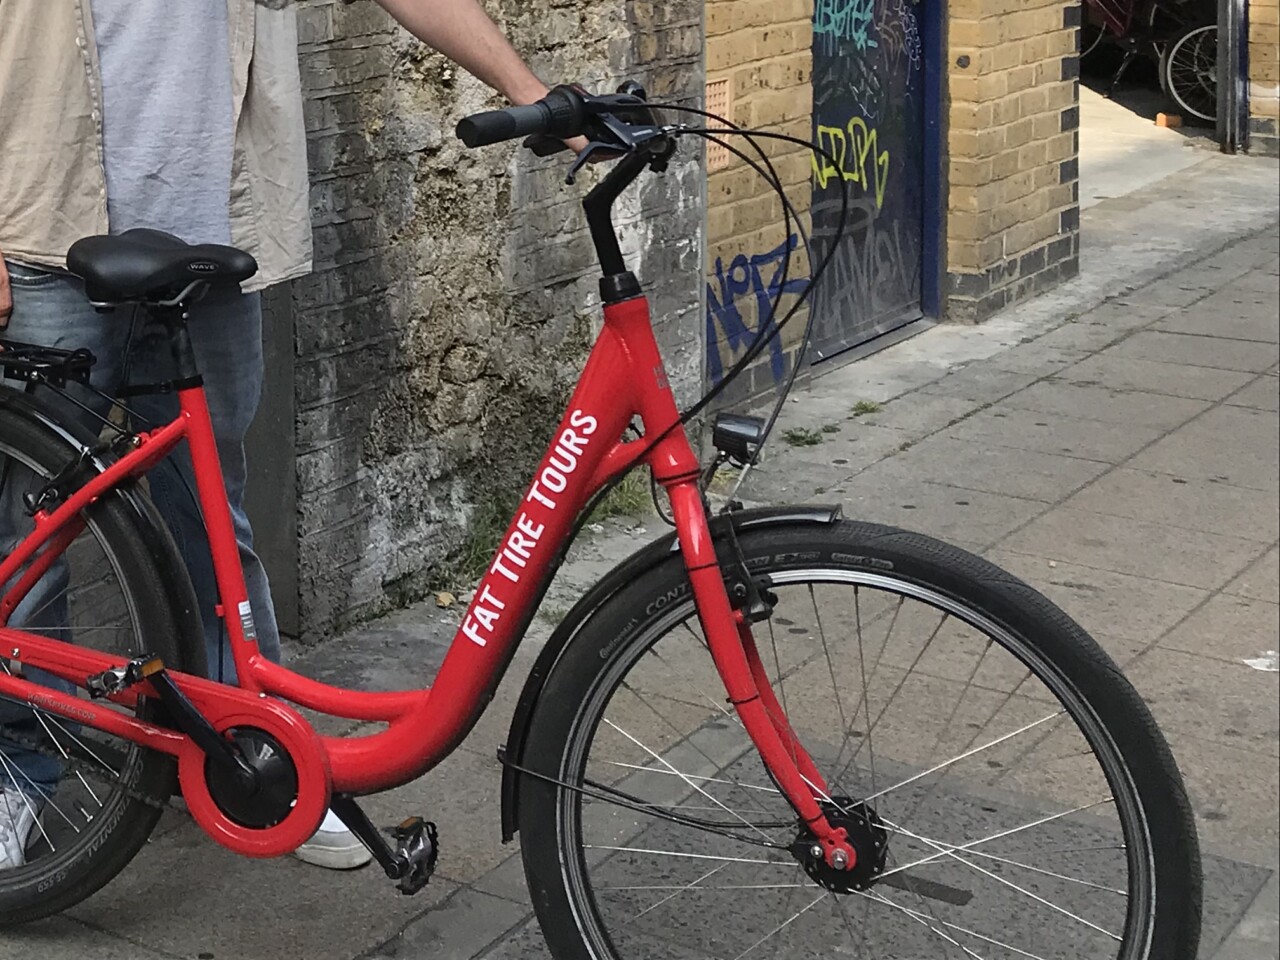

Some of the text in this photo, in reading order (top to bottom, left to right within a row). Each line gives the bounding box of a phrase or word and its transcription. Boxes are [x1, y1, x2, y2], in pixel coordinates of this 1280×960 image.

[461, 409, 598, 648] FAT TIRE TOURS
[645, 582, 689, 616] CONT
